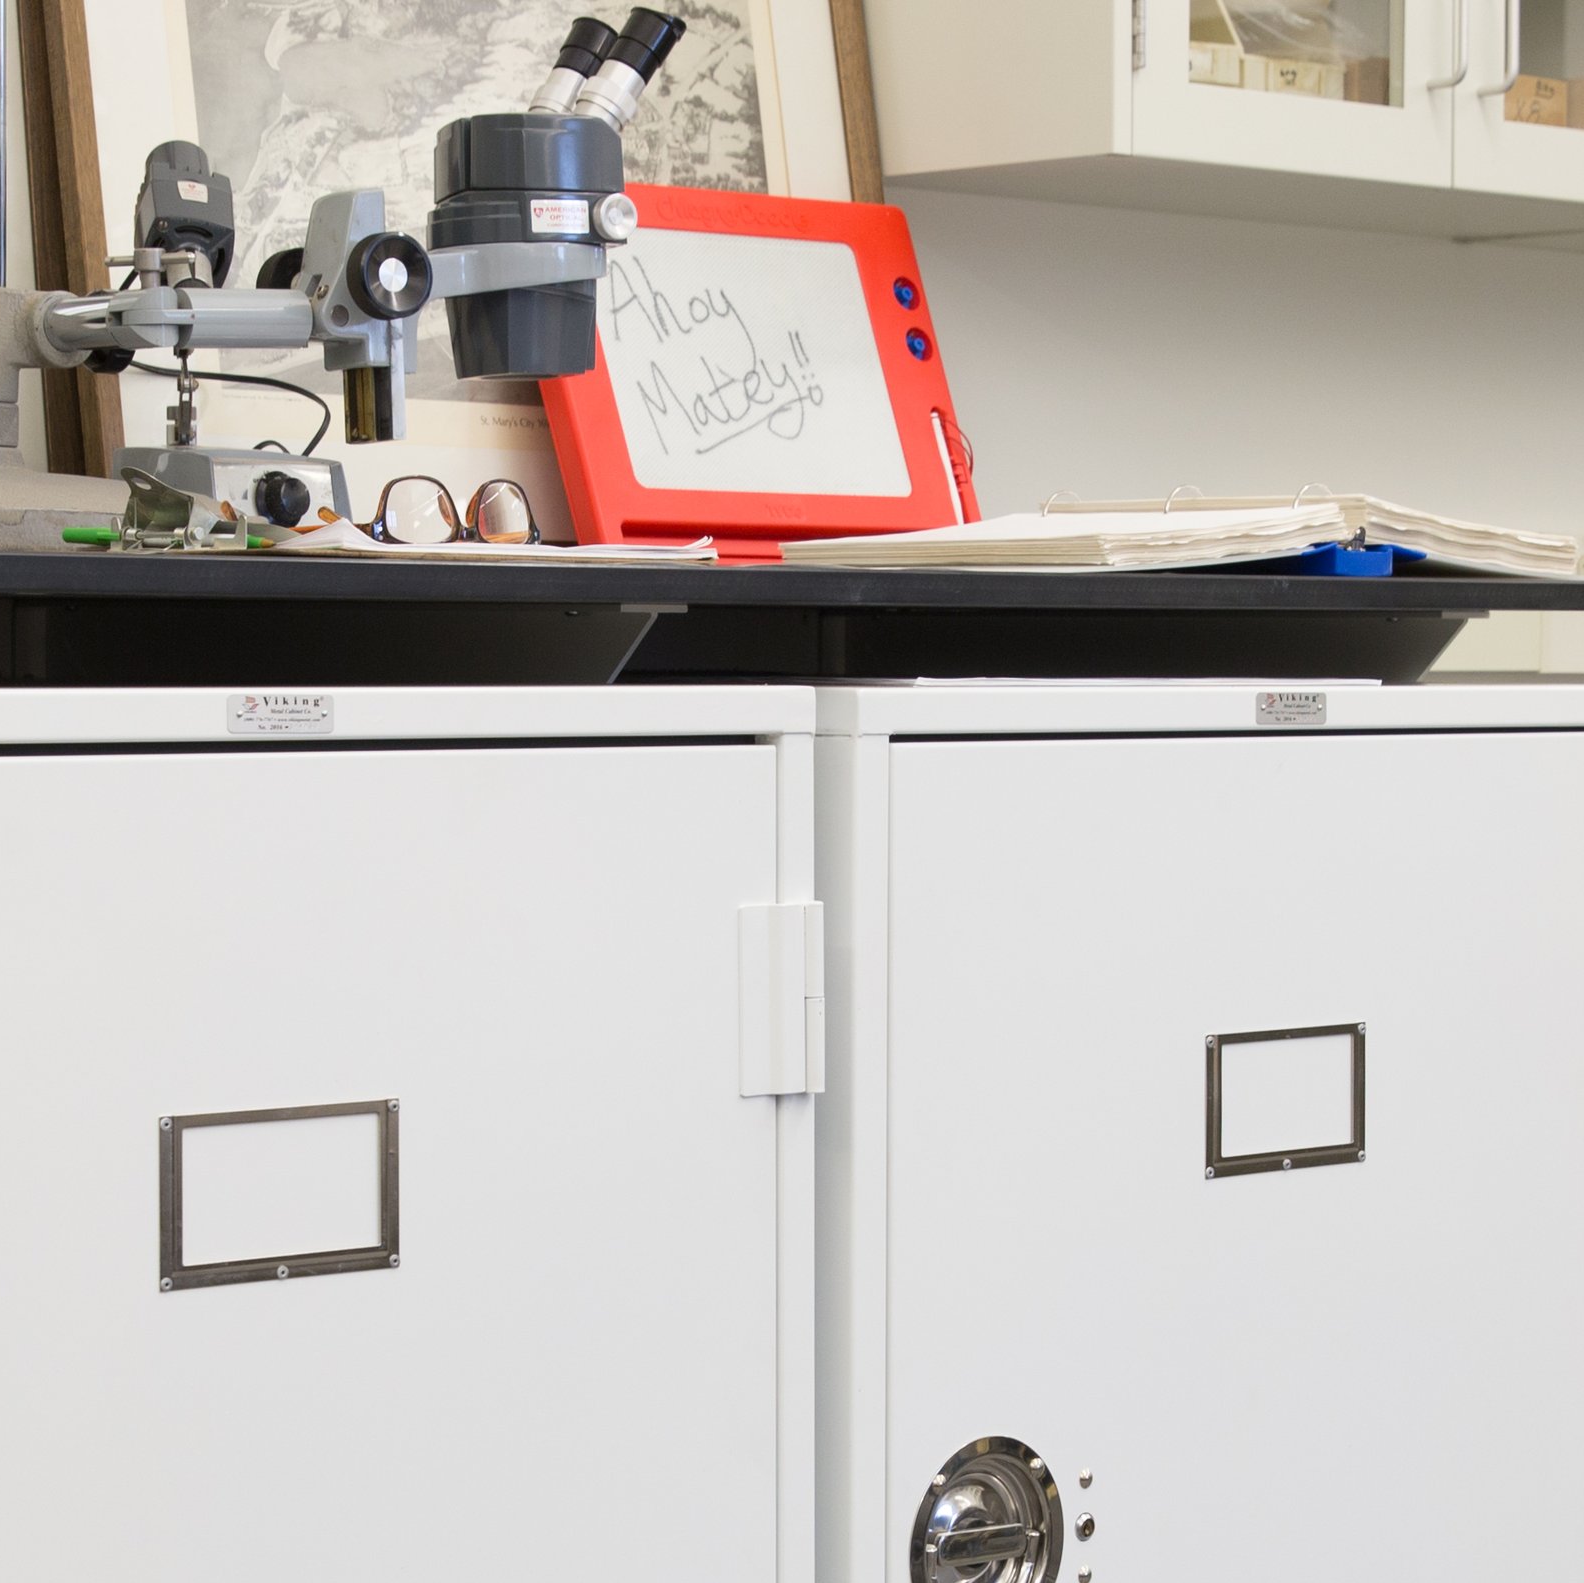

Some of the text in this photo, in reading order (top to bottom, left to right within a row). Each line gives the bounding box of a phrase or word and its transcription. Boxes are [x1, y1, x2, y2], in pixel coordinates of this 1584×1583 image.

[609, 256, 758, 372] Ahoy
[263, 696, 320, 707] Viking
[1279, 693, 1317, 703] Viking
